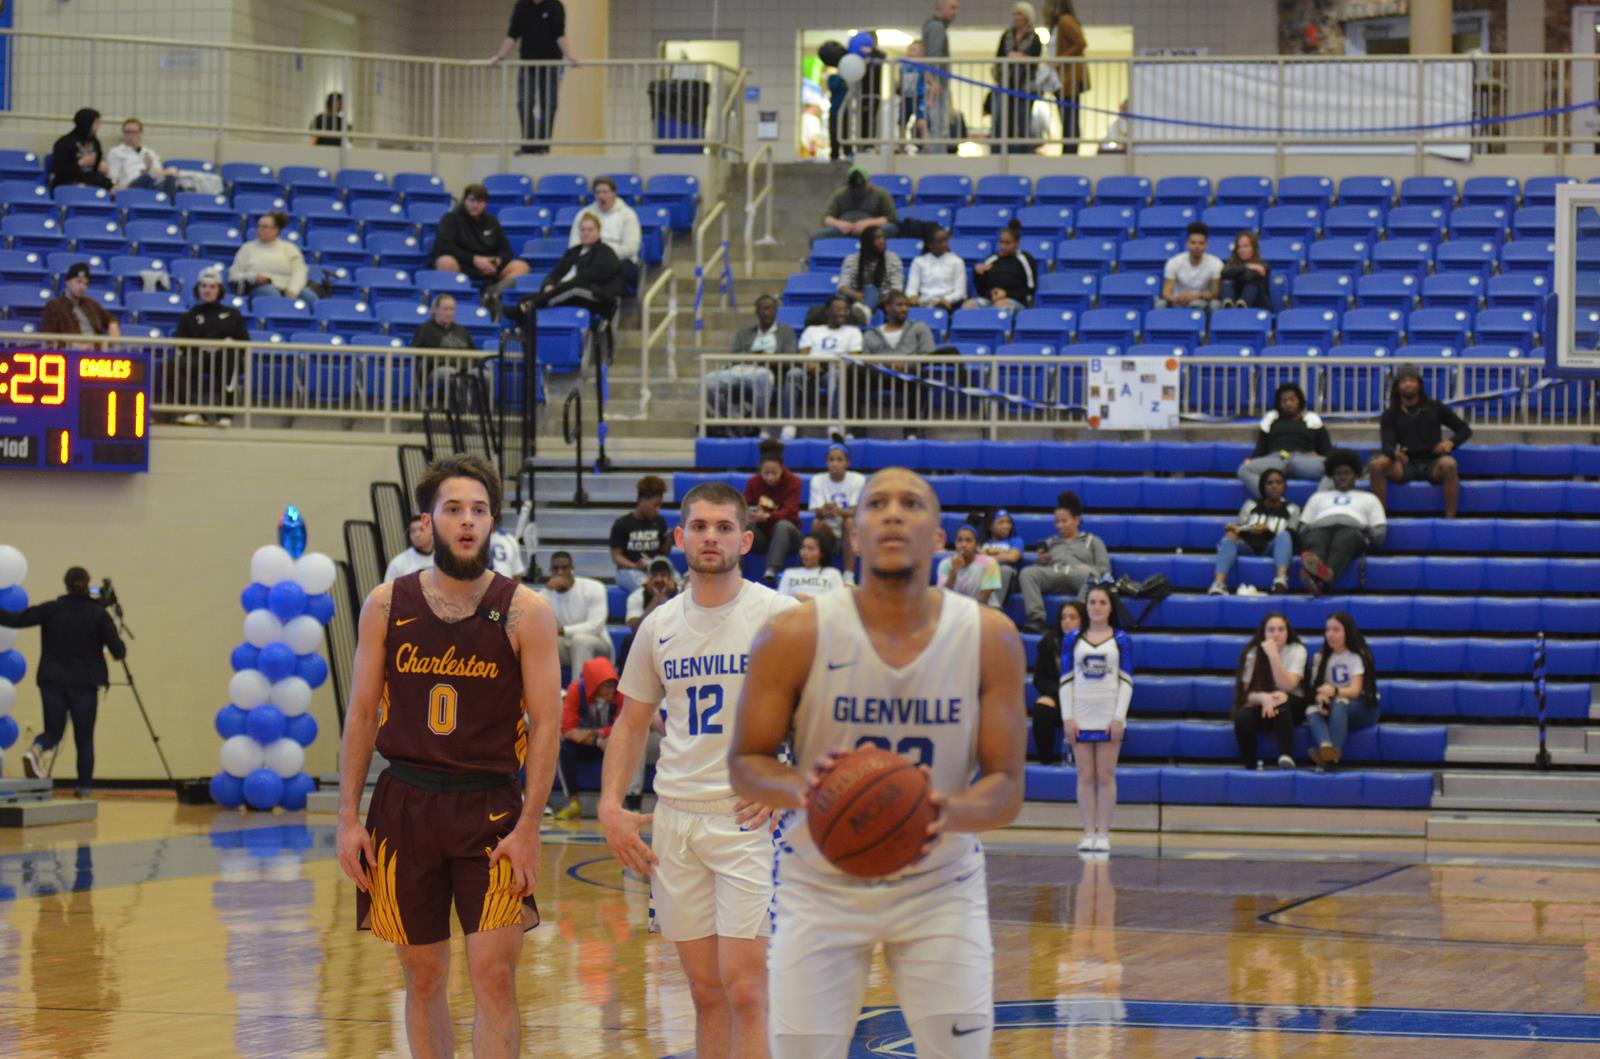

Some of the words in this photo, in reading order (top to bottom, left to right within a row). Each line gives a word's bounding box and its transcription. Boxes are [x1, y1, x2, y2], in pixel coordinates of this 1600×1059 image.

[79, 358, 132, 379] EAGLES
[107, 390, 145, 438] 11
[0, 436, 29, 459] iod
[60, 430, 69, 464] 1
[488, 610, 501, 622] 33
[396, 642, 499, 679] Charleston
[664, 654, 749, 680] GLENVILLE
[1331, 663, 1349, 685] G
[428, 683, 458, 736] 0
[686, 684, 724, 736] 12
[833, 696, 962, 726] GLENVILLE
